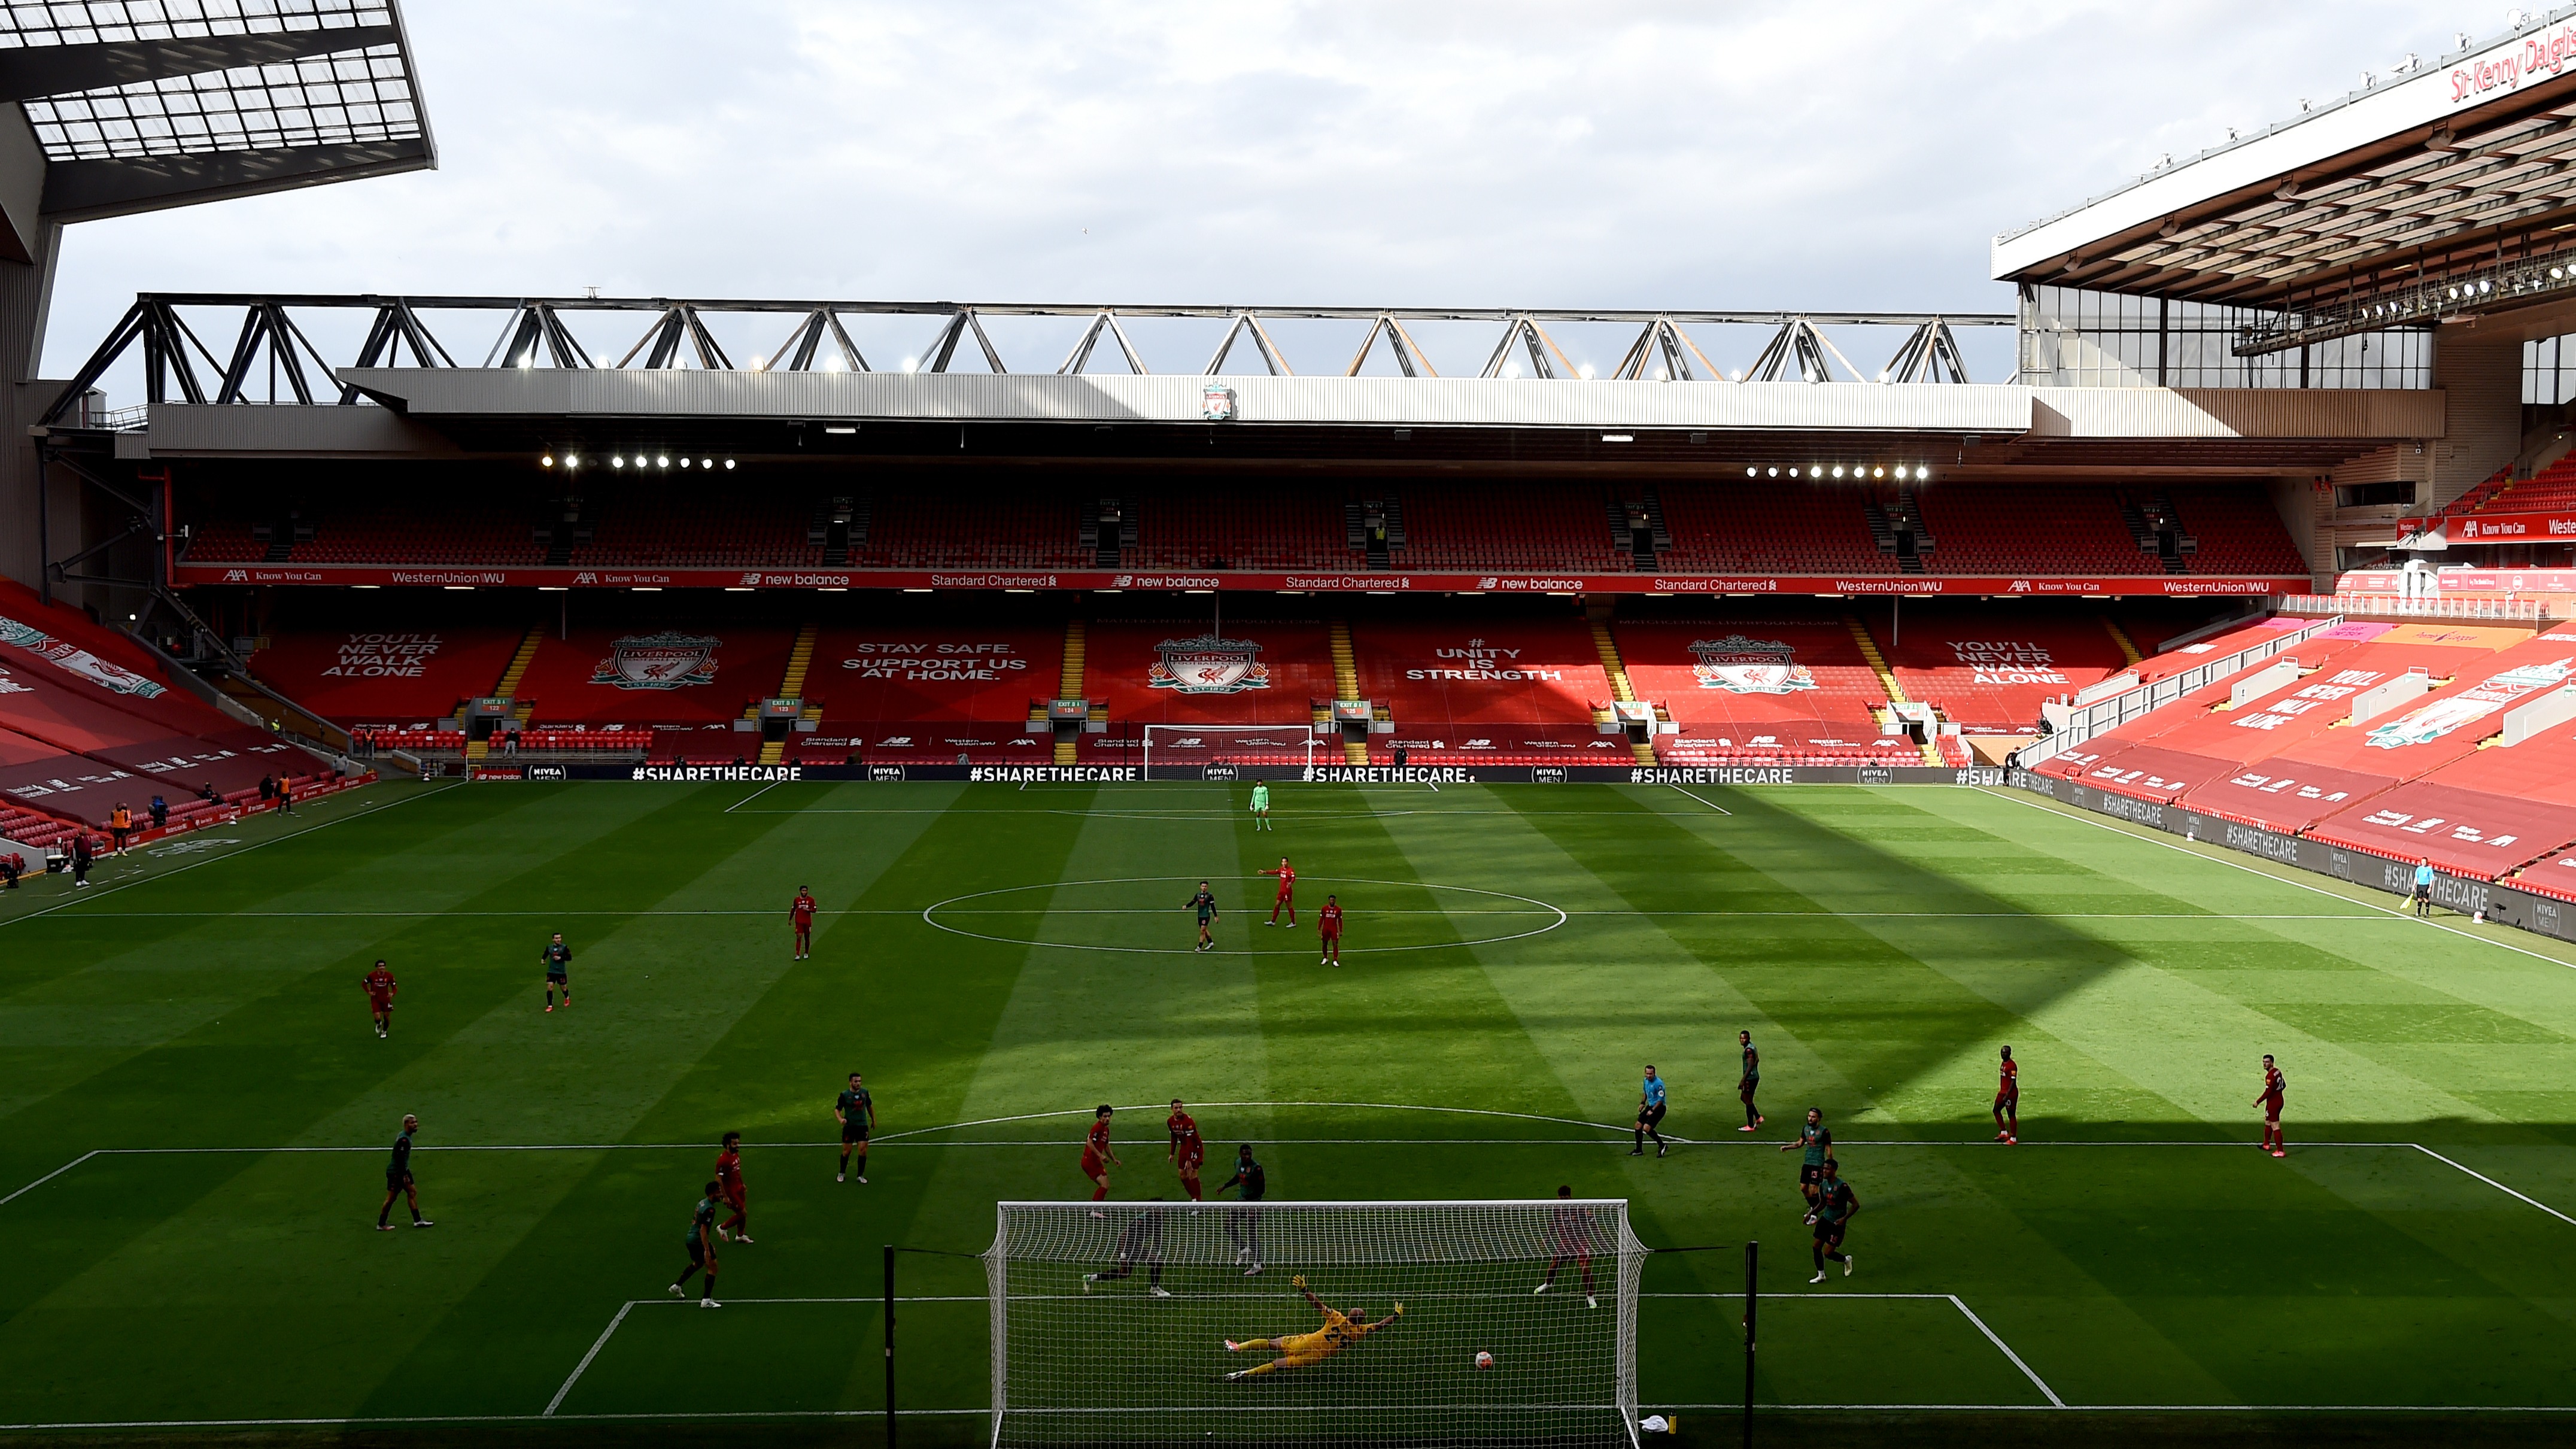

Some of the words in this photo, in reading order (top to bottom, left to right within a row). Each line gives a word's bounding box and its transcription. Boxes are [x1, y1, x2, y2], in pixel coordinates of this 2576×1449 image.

[2452, 69, 2472, 101] Sir
[2474, 53, 2523, 93] Kenny
[2461, 520, 2478, 537] AXA
[2482, 523, 2500, 534] Know
[2501, 523, 2513, 534] You
[2513, 522, 2525, 534] Can
[223, 570, 248, 581] AXA
[573, 572, 597, 584] AXA
[765, 576, 792, 585] new
[795, 573, 849, 585] balance
[931, 575, 985, 586] Standard
[989, 575, 1046, 586] Chartered
[1137, 578, 1164, 587] new
[1167, 576, 1219, 587] balance
[1286, 576, 1339, 588] Standard
[1342, 576, 1399, 588] Chartered
[1502, 580, 1528, 589] new
[1530, 578, 1583, 590] balance
[1654, 579, 1707, 591] Standard
[1710, 579, 1767, 591] Chartered
[2007, 580, 2031, 592] AXA
[349, 634, 443, 643] YOU'LL
[1468, 638, 1485, 648] #
[337, 645, 439, 654] NEVER
[856, 643, 928, 654] STAY
[935, 644, 1016, 654] SAFE.
[1436, 648, 1521, 658] UNITY
[1945, 642, 2048, 652] YOU'LL
[341, 655, 426, 666] WALK
[1955, 652, 2055, 662] NEVER
[842, 658, 981, 669] SUPPORT
[989, 660, 1027, 669] US
[1468, 659, 1495, 669] IS
[1969, 663, 2056, 673] WALK
[320, 666, 427, 677] ALONE
[861, 669, 900, 678] AT
[907, 670, 1001, 680] HOME.
[1406, 669, 1562, 681] STRENGTH
[1973, 673, 2070, 684] ALONE
[2292, 684, 2356, 701] NEVER
[2265, 698, 2324, 715] WALK
[632, 767, 801, 780] #SHARETHECARE
[970, 767, 1137, 782] #SHARETHECARE
[1303, 767, 1467, 782] #SHARETHECARE
[1631, 768, 1793, 783] #SHARETHECARE
[2103, 794, 2162, 824] #SHARETHECARE
[2226, 824, 2298, 862] #SHARETHECARE
[2332, 852, 2347, 865] NIVEA
[2384, 864, 2489, 911] #SHATHECARE
[2536, 903, 2557, 918] NIVEA
[2538, 916, 2554, 929] MEN
